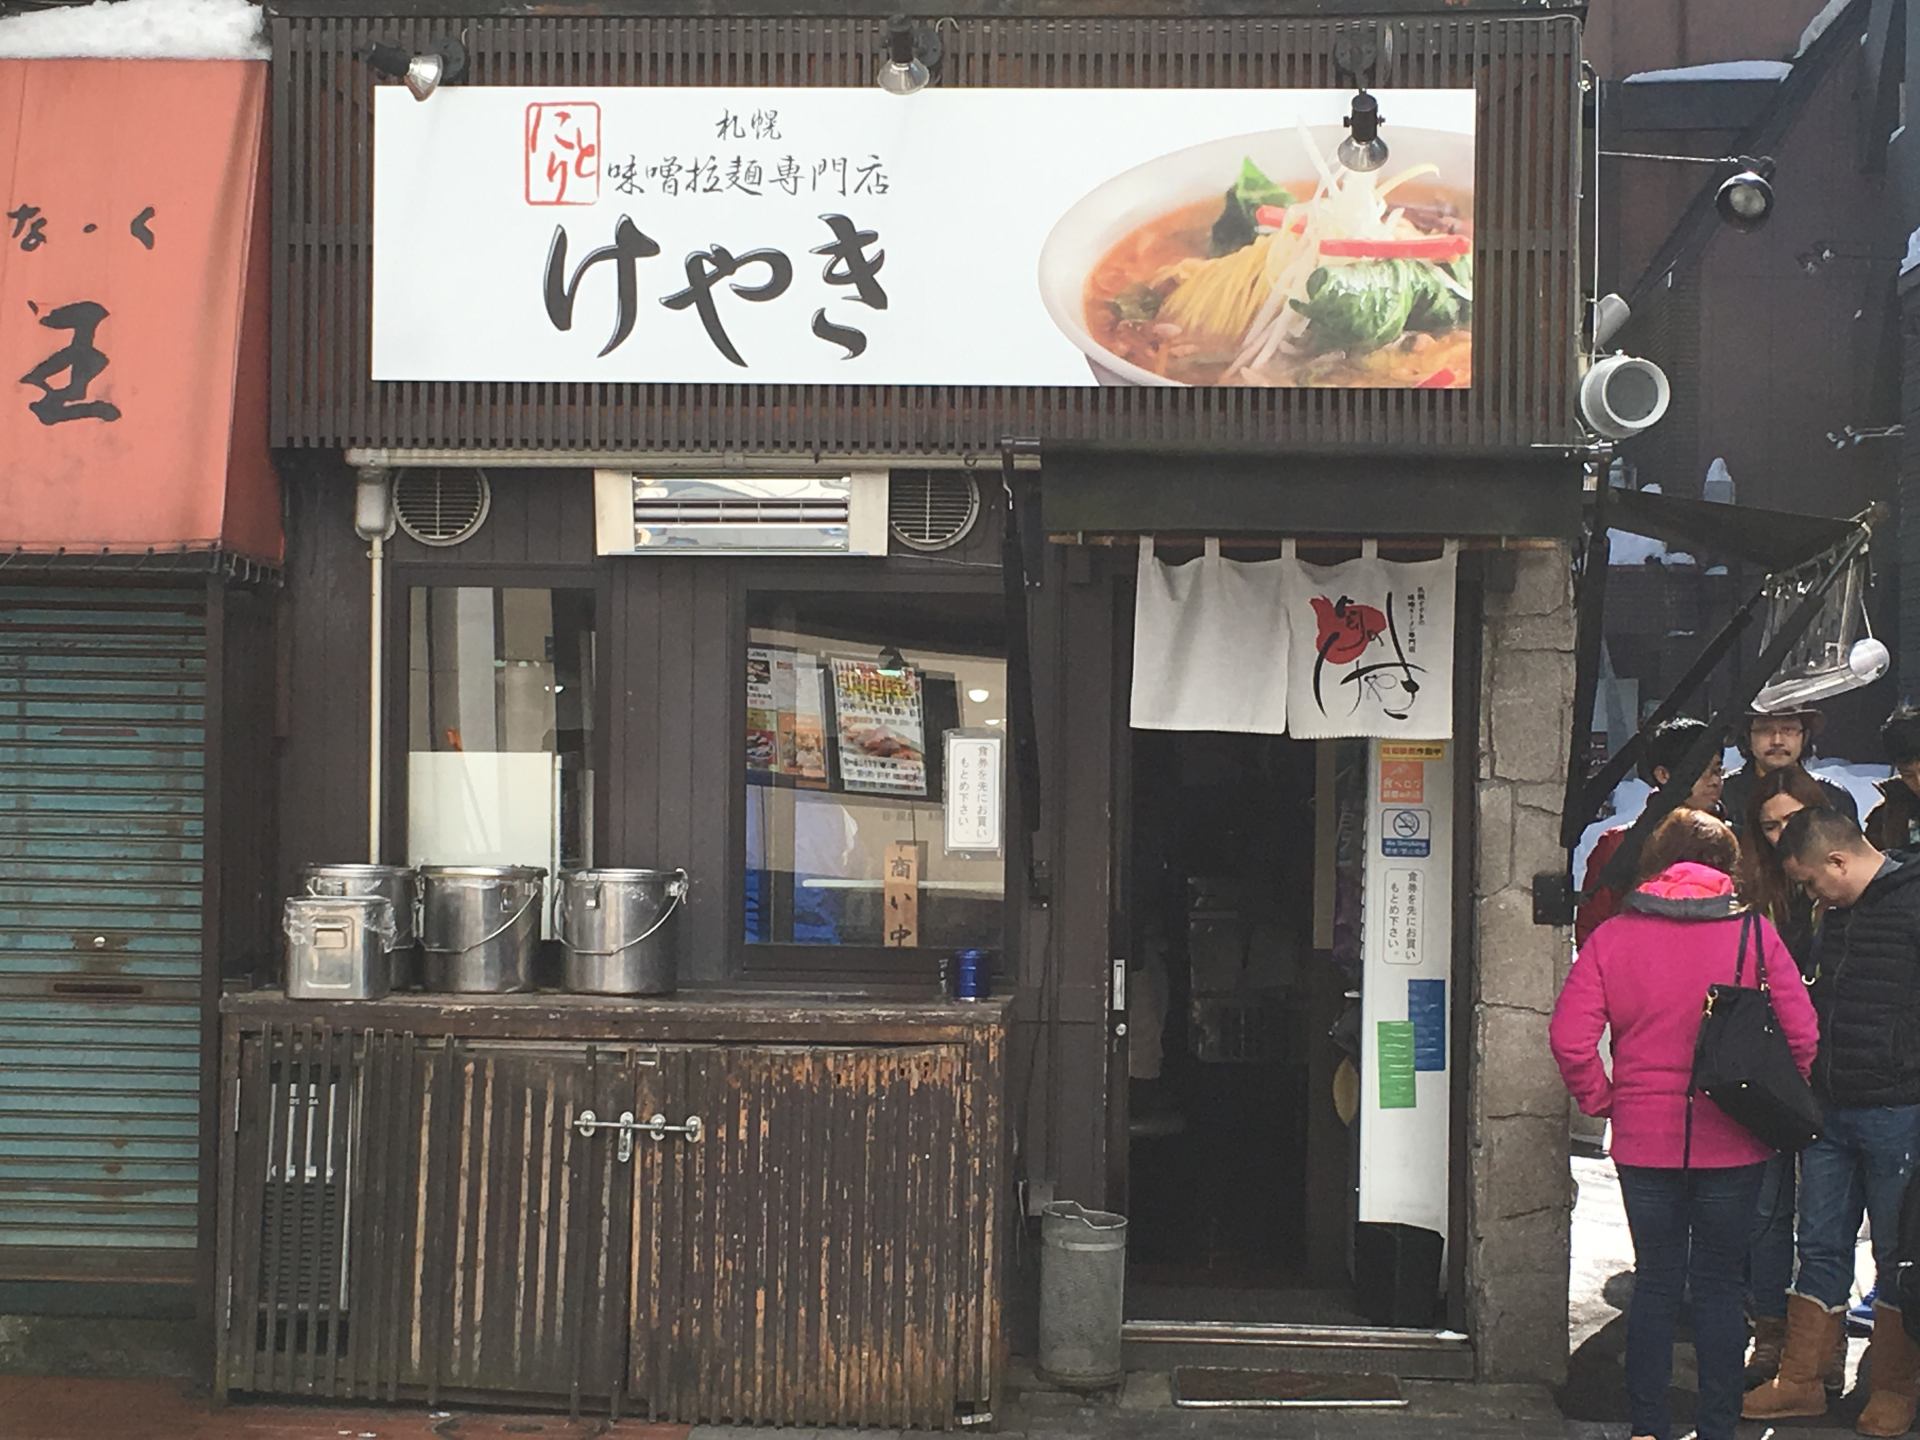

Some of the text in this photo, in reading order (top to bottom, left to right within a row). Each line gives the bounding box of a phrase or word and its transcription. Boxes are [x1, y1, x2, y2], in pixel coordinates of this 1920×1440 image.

[715, 108, 782, 141] 札幌
[543, 213, 888, 368] けやき
[889, 856, 913, 947] 商い中
[1404, 871, 1418, 960] 食券を先にお買い
